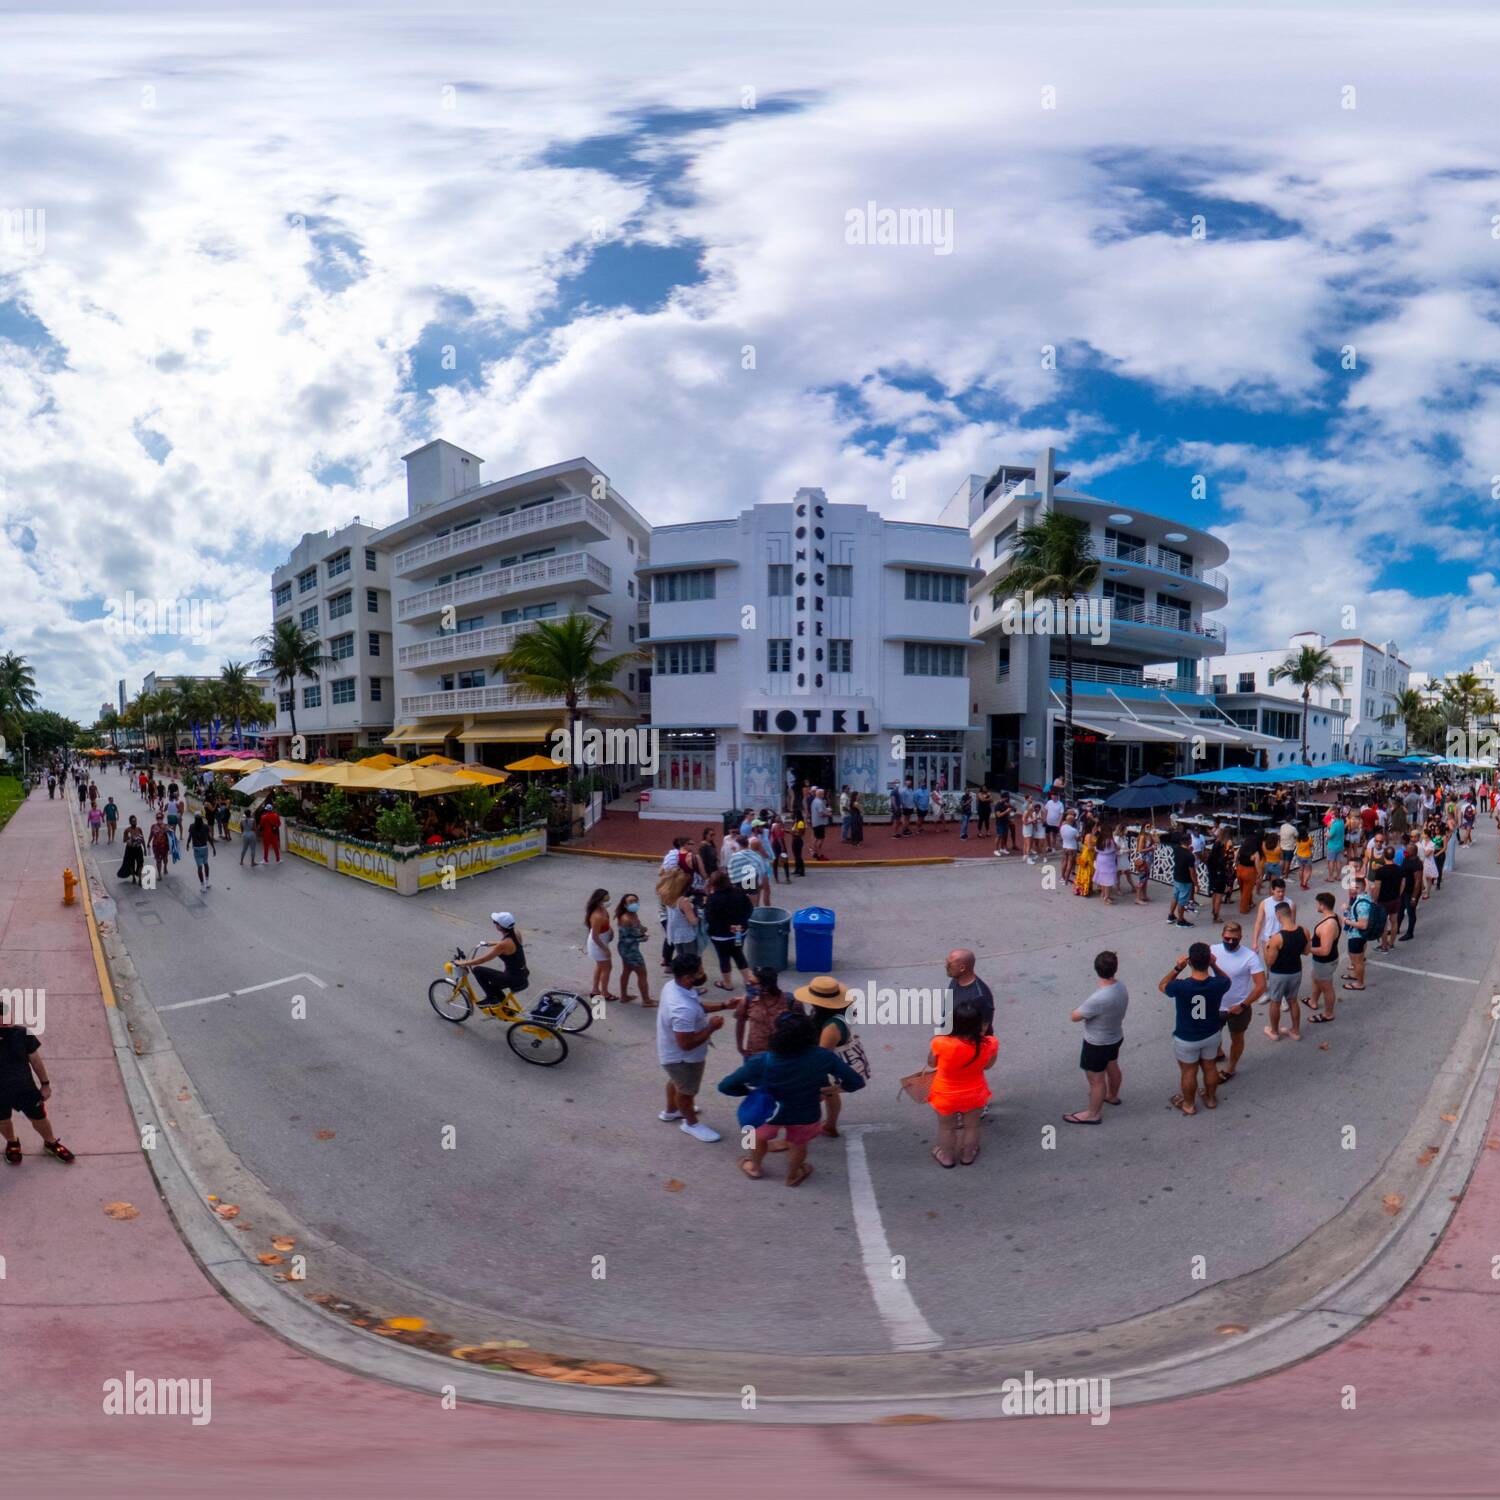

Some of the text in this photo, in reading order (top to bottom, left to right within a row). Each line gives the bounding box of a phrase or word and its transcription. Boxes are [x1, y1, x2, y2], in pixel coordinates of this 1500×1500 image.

[795, 504, 806, 688] CONGRESS
[815, 505, 825, 688] CONGRESS
[753, 709, 869, 733] HOTEL
[292, 831, 328, 861] SOCIAL
[435, 844, 491, 879] SOCIAL
[344, 847, 395, 882] SOCIAL
